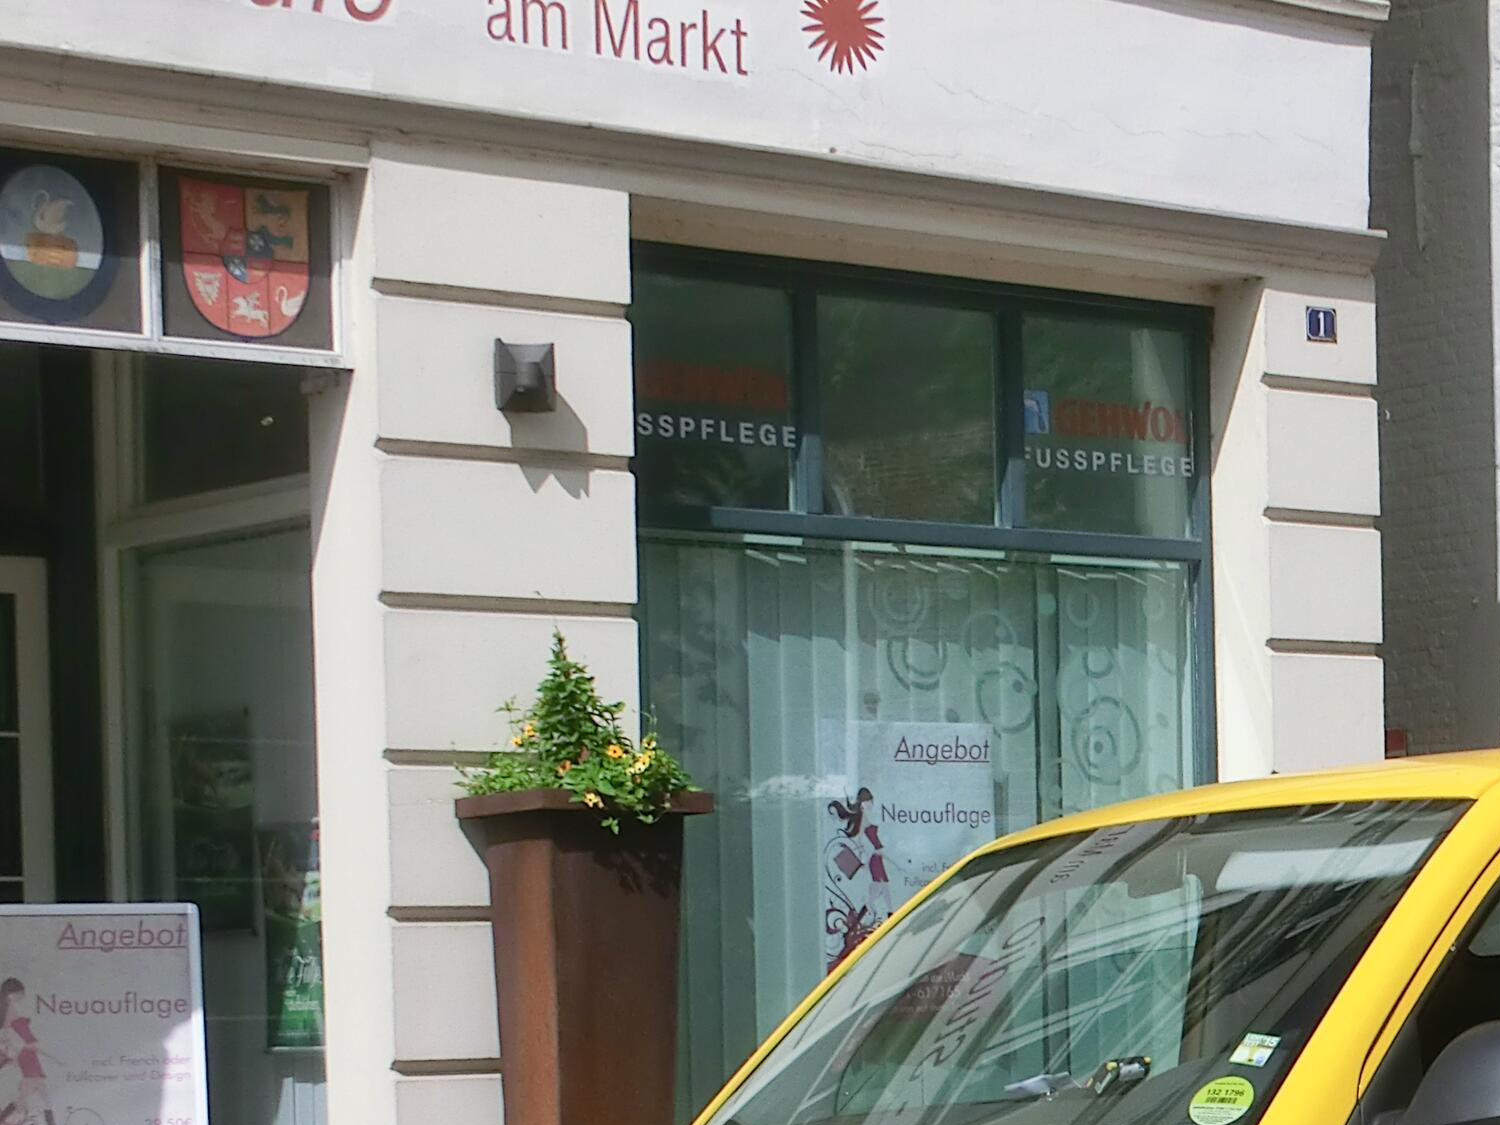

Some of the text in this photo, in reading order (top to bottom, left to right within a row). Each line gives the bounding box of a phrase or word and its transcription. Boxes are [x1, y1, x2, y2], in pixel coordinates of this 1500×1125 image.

[487, 0, 749, 76] am Markt
[1317, 311, 1326, 338] 1
[637, 412, 797, 449] SSPFLEGE
[894, 735, 990, 765] Angebot
[881, 802, 991, 828] Neuauflage
[57, 919, 188, 953] Angebot
[35, 991, 188, 1019] Neuauflage
[120, 1055, 160, 1066] French
